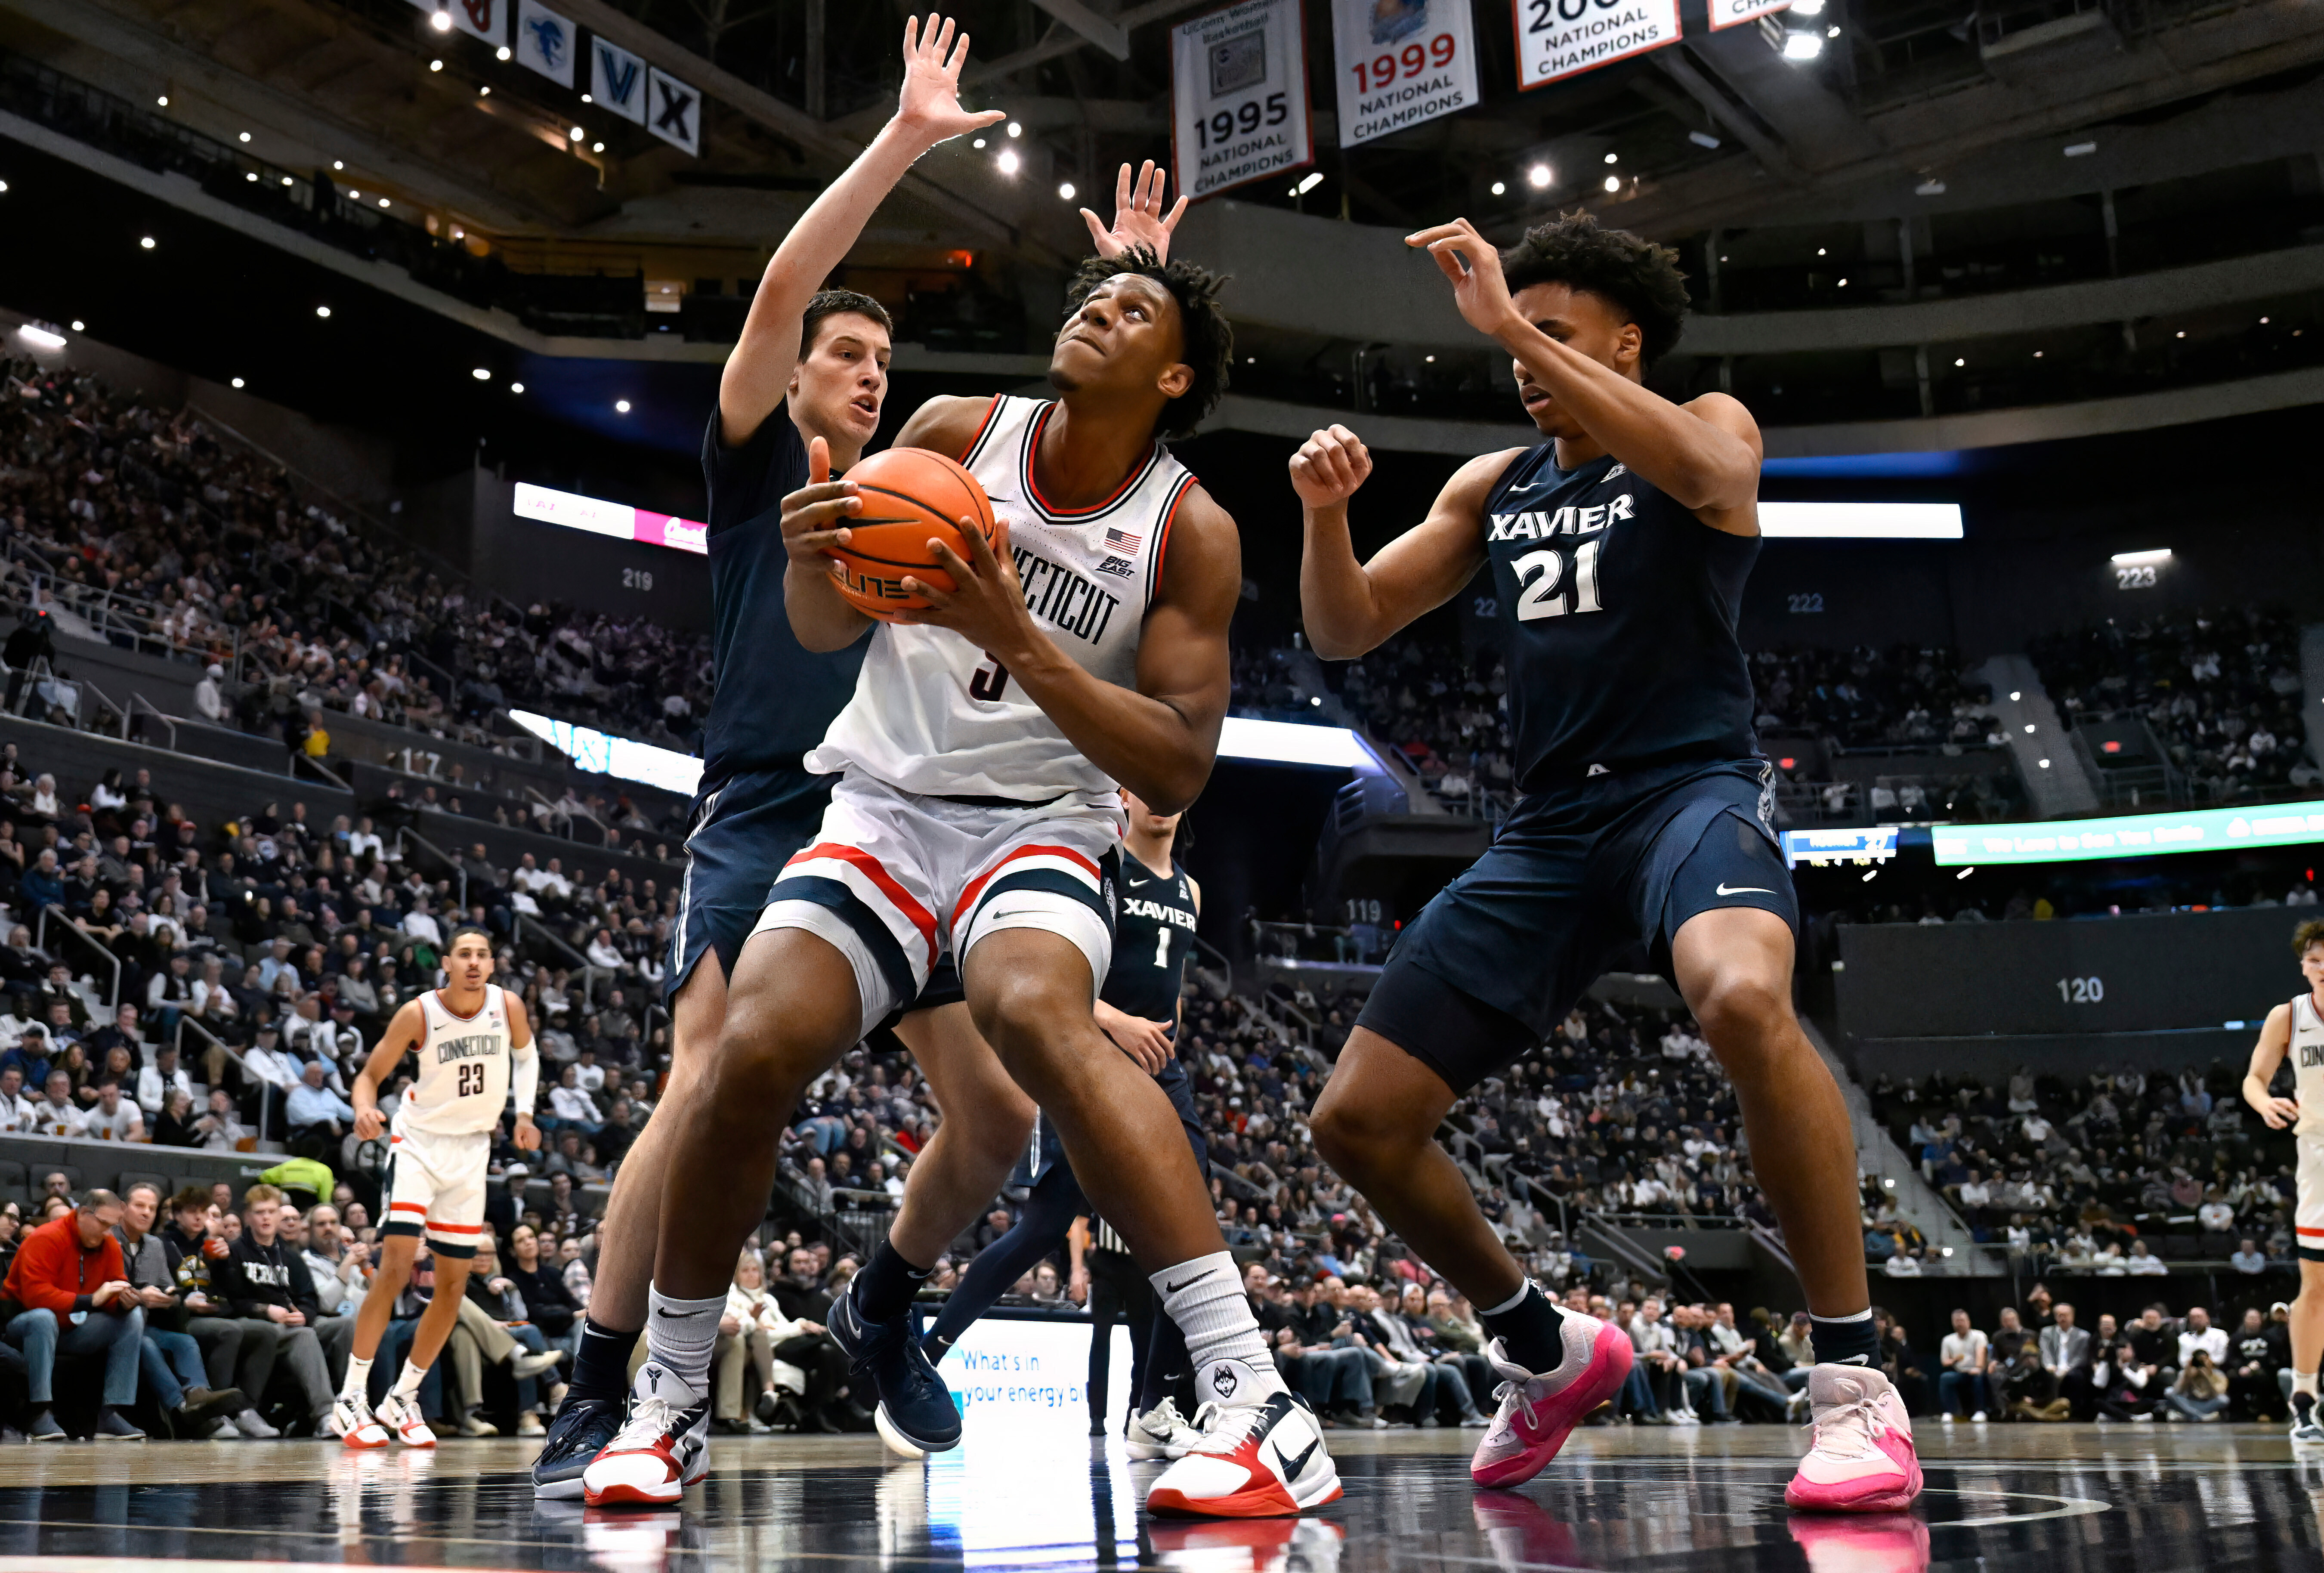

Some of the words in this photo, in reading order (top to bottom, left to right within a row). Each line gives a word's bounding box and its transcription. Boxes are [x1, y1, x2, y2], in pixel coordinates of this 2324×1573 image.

[1528, 0, 1621, 34] 20
[1545, 7, 1648, 52] NATIONAL
[1351, 33, 1455, 94] 1999
[1539, 25, 1659, 74] CHAMPIONS
[656, 80, 693, 142] X
[1360, 74, 1453, 116] NATIONAL
[1194, 92, 1287, 149] 1995
[1354, 91, 1462, 138] CHAMPIONS
[1200, 133, 1286, 170] NATIONAL
[1195, 149, 1293, 192] CHAMPIONS
[1487, 494, 1635, 541] XAVIER
[1099, 562, 1135, 576] EAST
[1105, 556, 1132, 568] BIG
[2117, 566, 2156, 590] 223
[831, 569, 909, 599] LITE
[1510, 541, 1603, 621] 21
[1474, 596, 1497, 616] 22
[1787, 593, 1824, 613] 222
[1122, 898, 1196, 933] XAVIER
[1346, 898, 1381, 922] 119
[1153, 927, 1171, 968] 1
[2056, 977, 2104, 1003] 120
[438, 1035, 501, 1064] CONNECTICUT
[459, 1063, 484, 1097] 23
[961, 1349, 1020, 1371] What's
[1025, 1350, 1039, 1371] in
[964, 1387, 1002, 1407] your
[1008, 1387, 1063, 1407] energy
